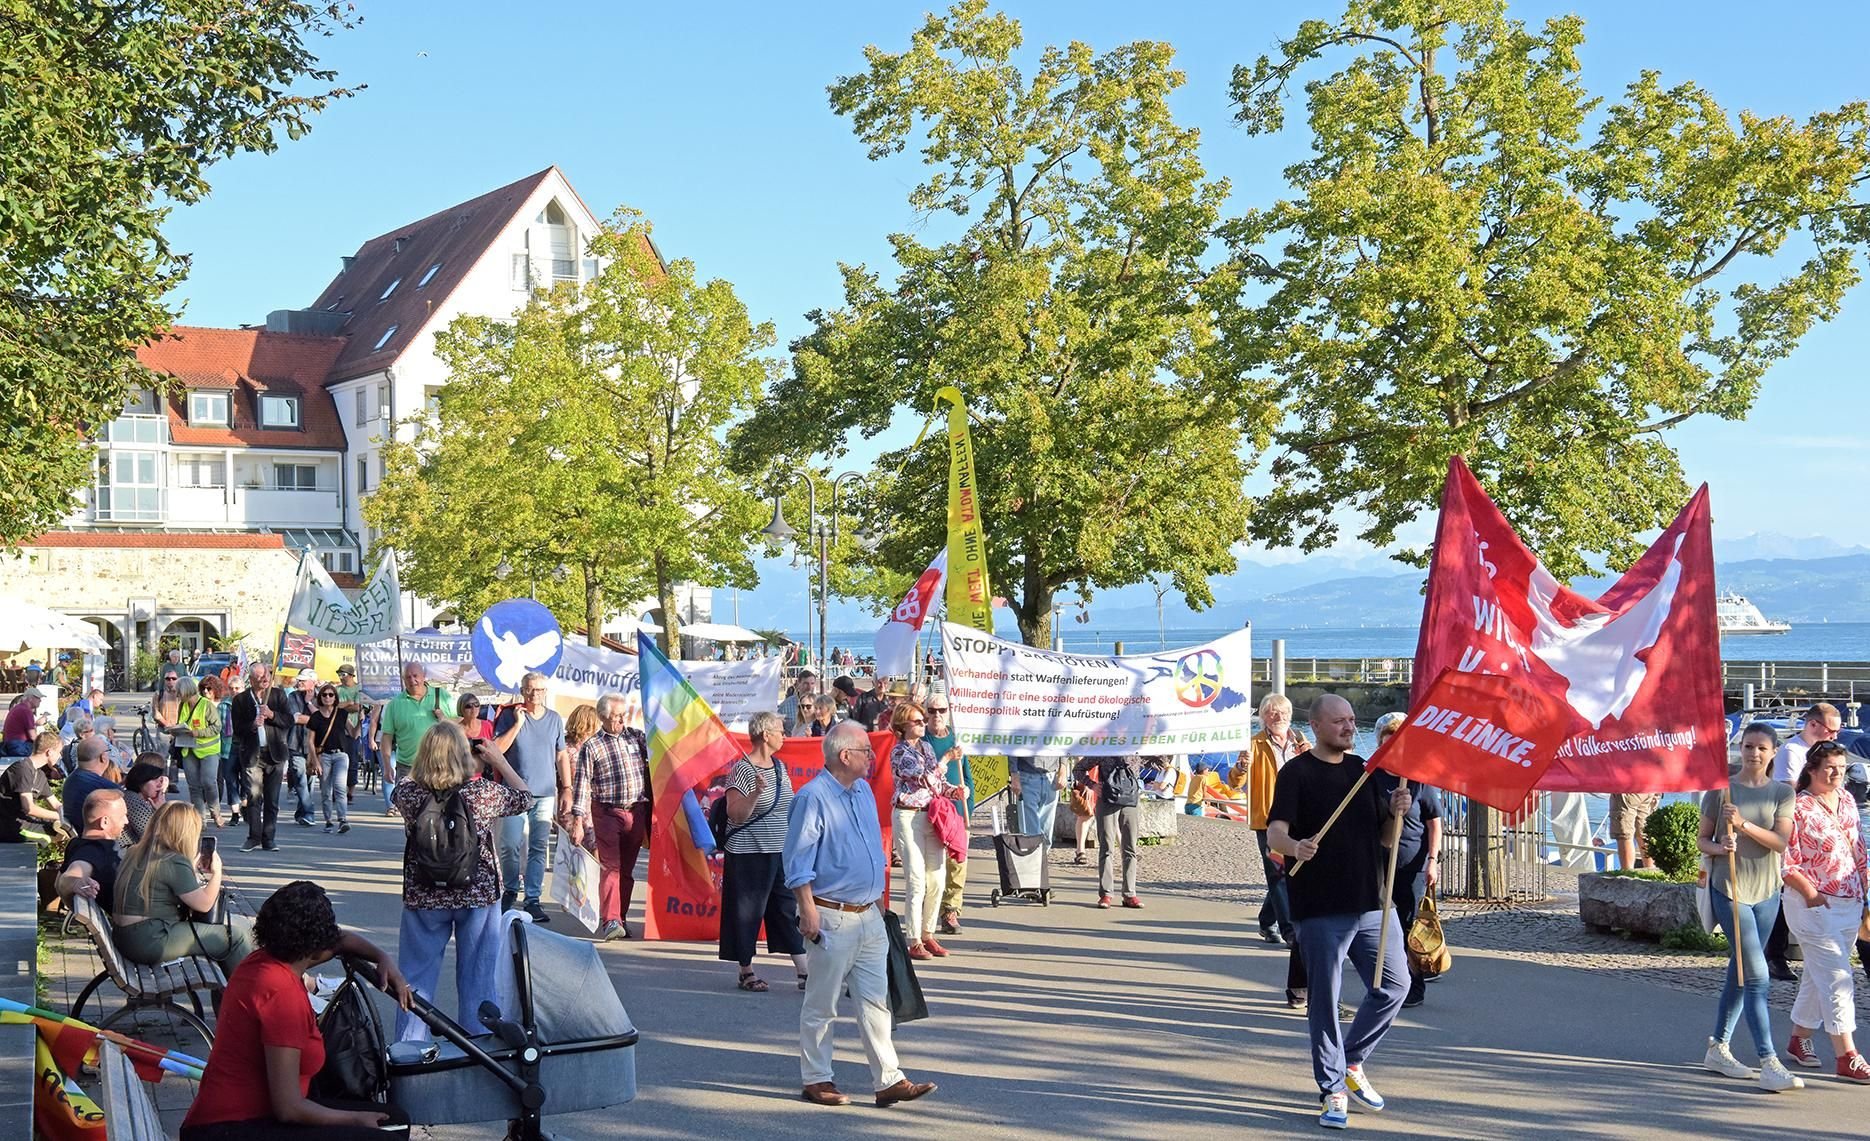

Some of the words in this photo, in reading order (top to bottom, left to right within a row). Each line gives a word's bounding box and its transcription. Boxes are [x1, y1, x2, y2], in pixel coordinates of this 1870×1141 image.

[415, 638, 454, 650] FÜHRT
[361, 651, 454, 663] KLIMAWANDEL
[457, 650, 472, 663] FÜ
[1056, 655, 1109, 669] TÖTEN
[362, 665, 379, 676] ZU
[383, 666, 399, 676] KR
[556, 664, 640, 693] atomwaffe
[951, 667, 1008, 681] Verhandeln
[1011, 673, 1033, 682] statt
[1035, 674, 1128, 687] Waffenlieferungen!
[950, 687, 1000, 700] Milliarden
[1002, 690, 1017, 700] für
[1019, 692, 1040, 701] eine
[1042, 693, 1075, 704] soziale
[1077, 695, 1096, 704] und
[1098, 695, 1151, 706] ökologische
[949, 703, 1021, 716] Friedenspolitik
[1023, 707, 1046, 717] statt
[1048, 708, 1062, 718] für
[1063, 709, 1121, 721] Aufrüstung!
[1411, 705, 1460, 735] DIE
[957, 733, 1038, 745] ICHERHEIT
[1042, 736, 1074, 746] UND
[1078, 736, 1127, 746] GUTES
[1132, 735, 1176, 745] LEBEN
[1181, 732, 1207, 743] FÜR
[1211, 728, 1242, 742] ALLE
[666, 896, 718, 918] Raus
